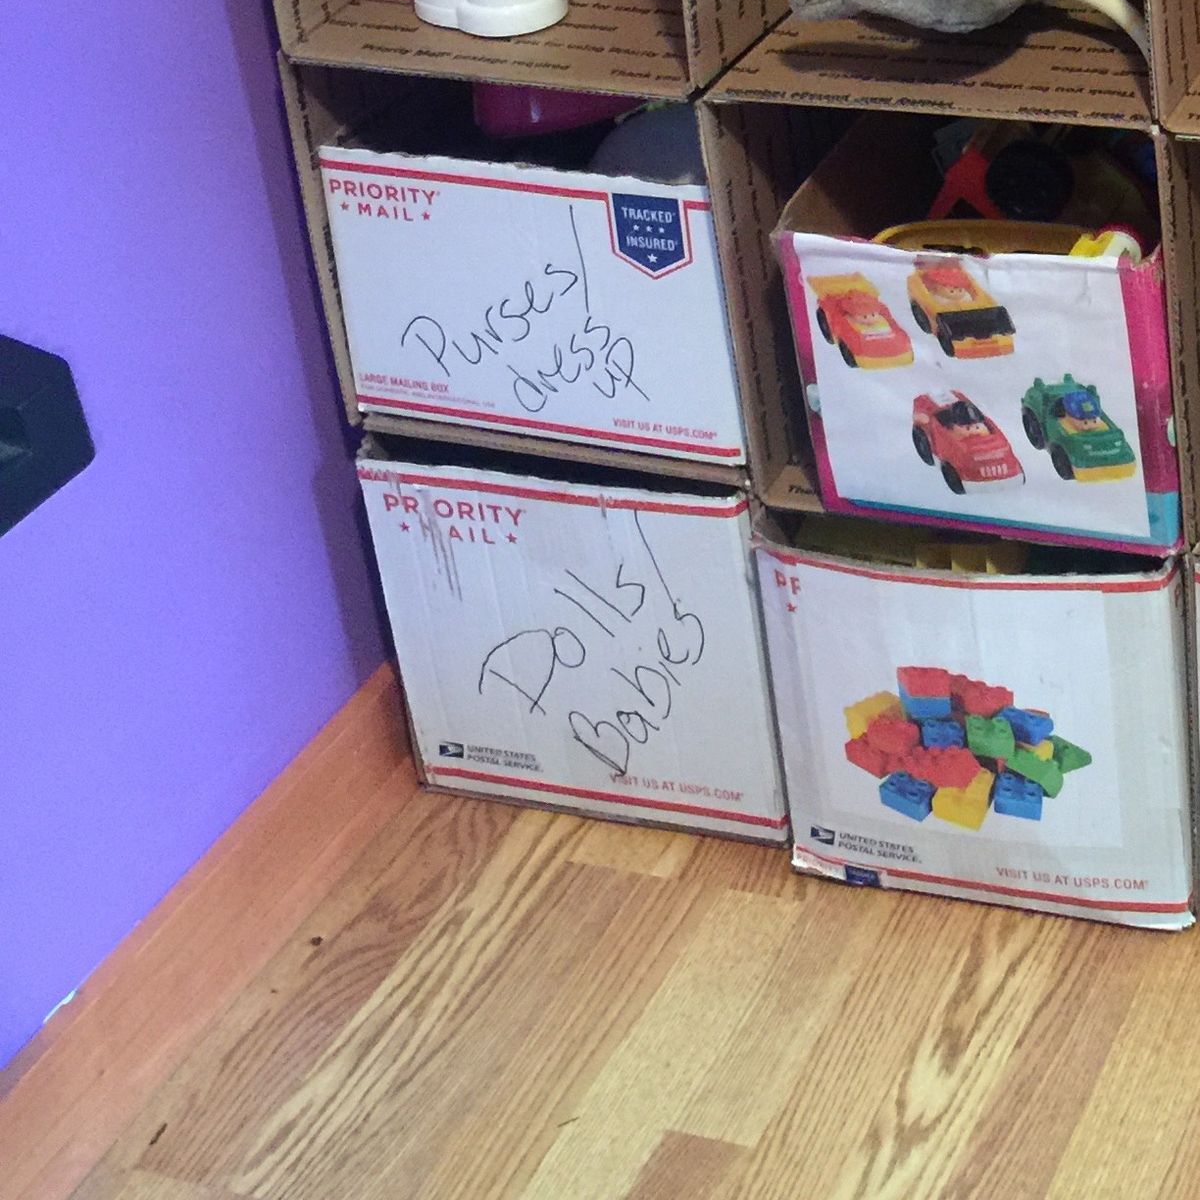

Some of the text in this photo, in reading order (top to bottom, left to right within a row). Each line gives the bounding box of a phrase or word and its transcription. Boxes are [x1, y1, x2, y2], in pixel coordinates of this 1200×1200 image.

[329, 178, 437, 207] PRIORITY
[357, 202, 414, 222] MAIL
[621, 206, 673, 224] TRACKED
[625, 234, 676, 252] INSURED
[431, 382, 450, 393] BOX
[612, 417, 636, 429] VISIT
[637, 420, 651, 431] US
[652, 422, 663, 433] AT
[382, 493, 522, 527] PRORITY
[467, 744, 537, 762] UNITED STATES
[642, 777, 659, 790] US
[662, 780, 676, 792] AT
[838, 840, 876, 856] POSTAL
[839, 832, 915, 854] UNITED STATES
[995, 866, 1028, 880] VISIT
[1032, 870, 1051, 883] US
[1054, 874, 1070, 886] AT
